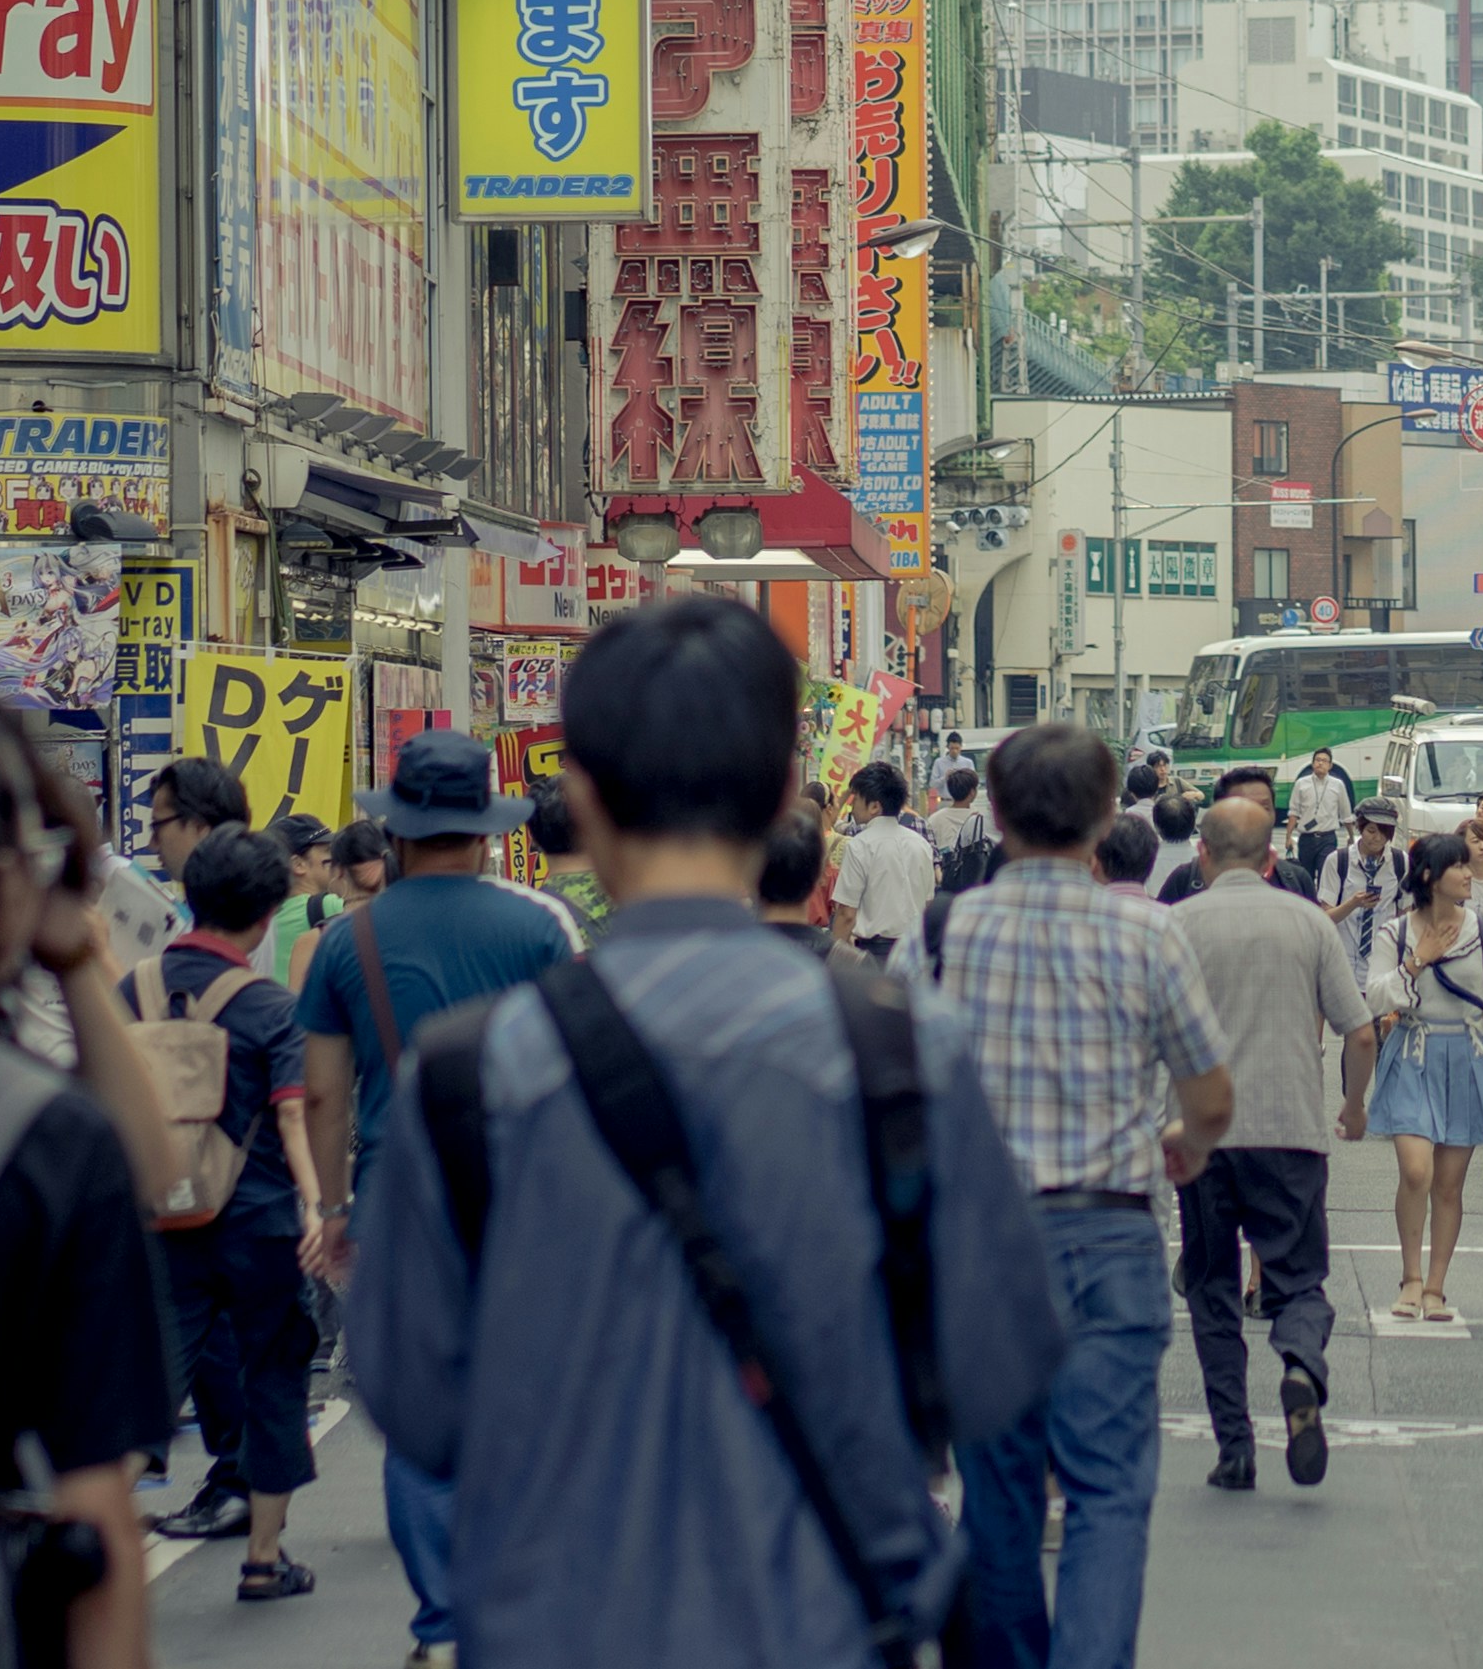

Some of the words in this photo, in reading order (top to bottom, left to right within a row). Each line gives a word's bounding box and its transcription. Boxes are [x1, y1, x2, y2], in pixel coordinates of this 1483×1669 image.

[462, 173, 635, 199] TRADER2
[124, 580, 176, 607] VD
[1318, 604, 1332, 618] 40
[508, 659, 555, 673] JCB
